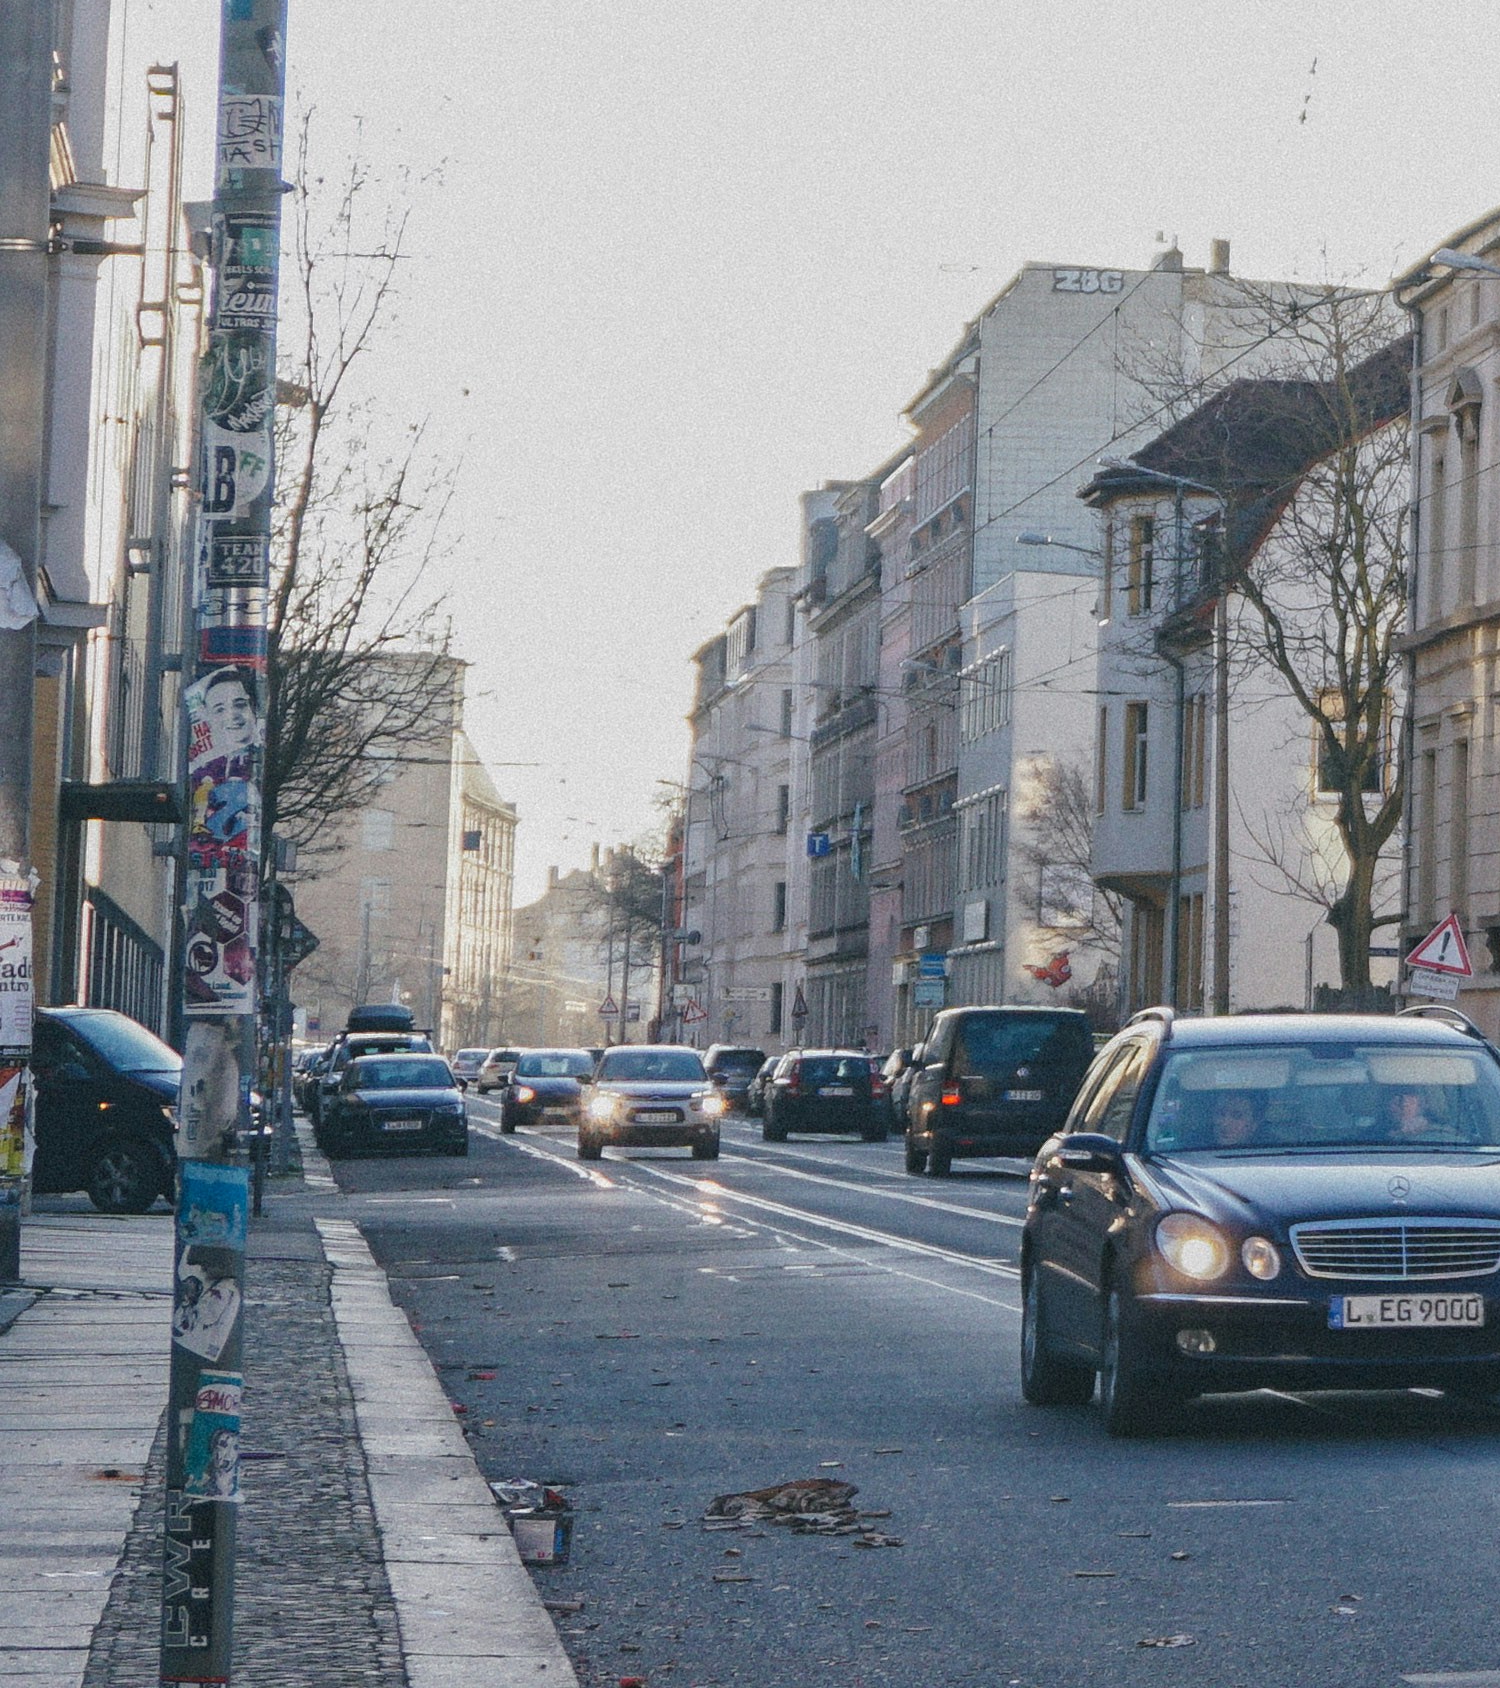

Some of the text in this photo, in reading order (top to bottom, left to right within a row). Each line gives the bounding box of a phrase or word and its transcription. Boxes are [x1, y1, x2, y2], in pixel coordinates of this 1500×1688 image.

[1346, 1298, 1479, 1323] L EG 9000
[191, 1536, 211, 1648] CRE
